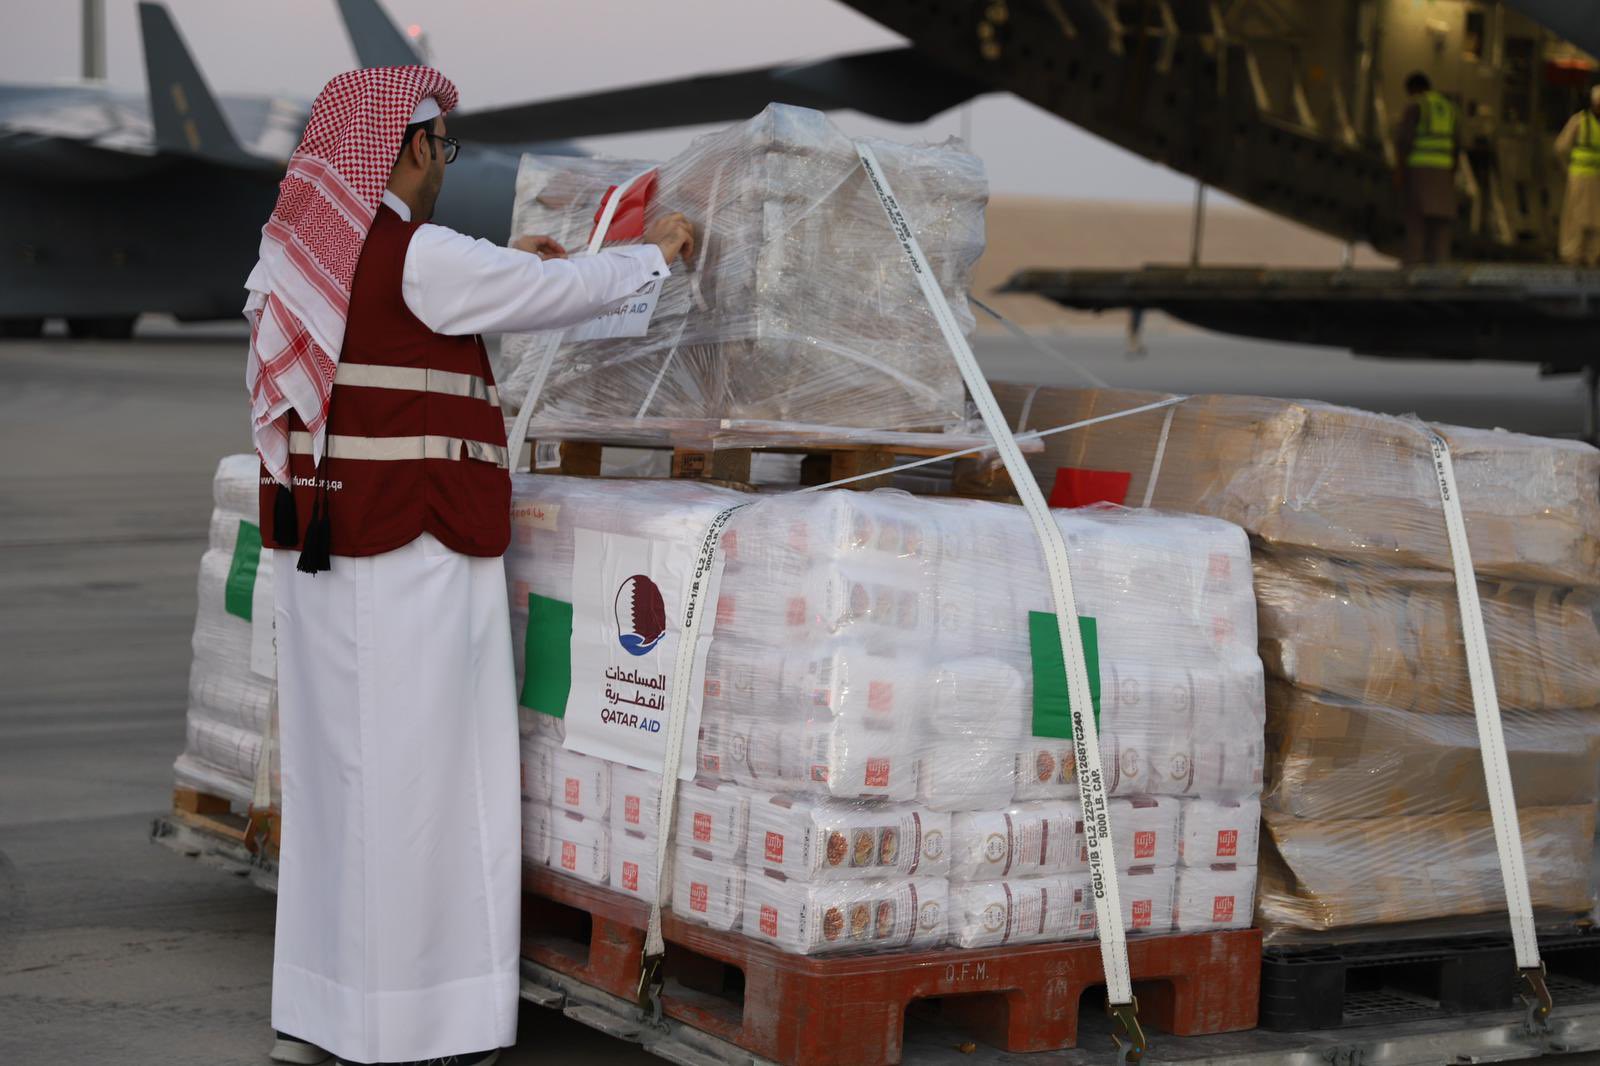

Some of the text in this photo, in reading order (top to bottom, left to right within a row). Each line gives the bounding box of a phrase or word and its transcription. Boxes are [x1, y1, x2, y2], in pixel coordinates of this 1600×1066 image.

[704, 547, 715, 571] 5000
[685, 581, 700, 628] CGU-1/B
[695, 557, 707, 579] CL2
[605, 665, 666, 691] المساعدات
[605, 683, 665, 711] القطرية
[600, 708, 661, 733] QATAR AID
[1091, 768, 1102, 792] CAP.
[1087, 825, 1098, 848] CL2
[1097, 813, 1108, 838] 5000
[1090, 850, 1105, 899] CGU-1/B
[945, 961, 989, 983] Q.F.M.
